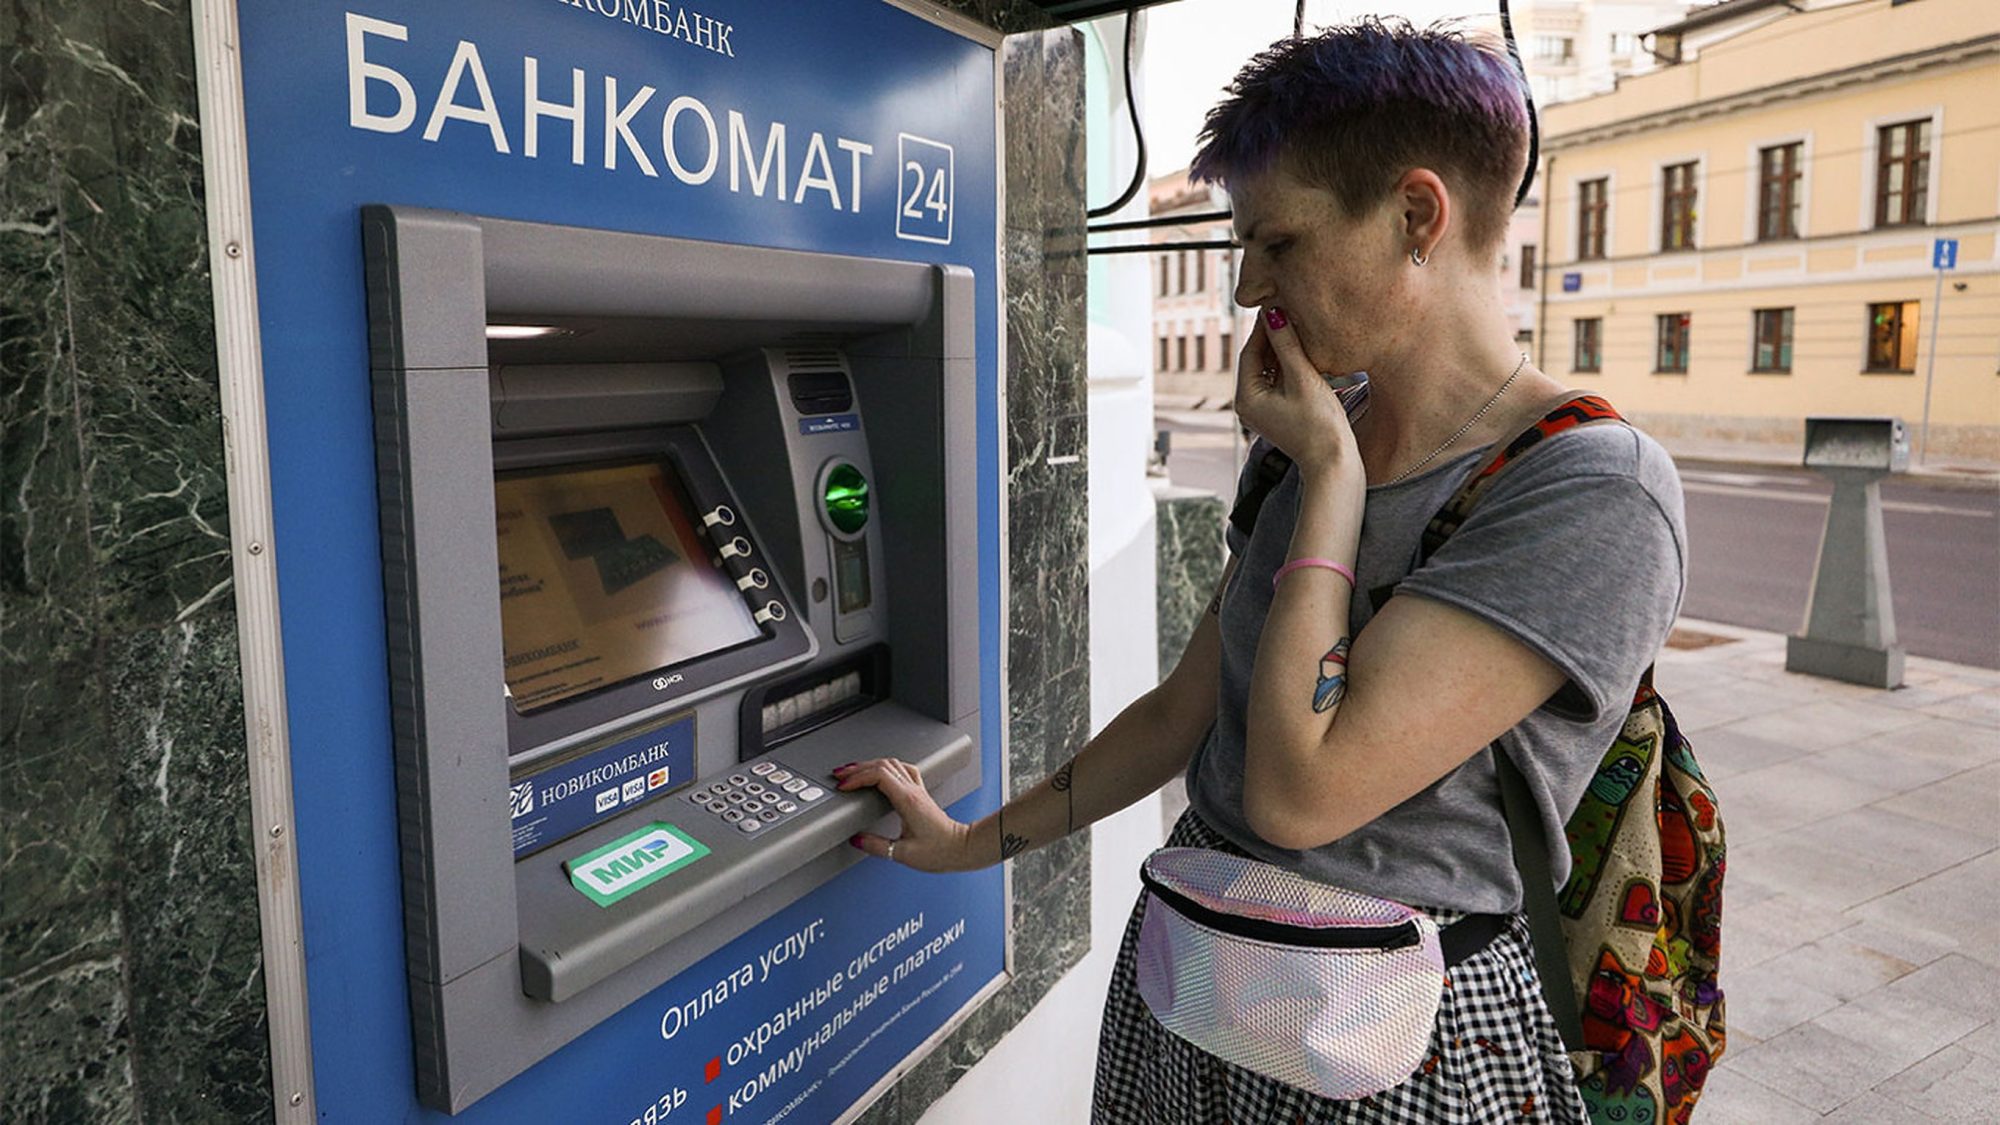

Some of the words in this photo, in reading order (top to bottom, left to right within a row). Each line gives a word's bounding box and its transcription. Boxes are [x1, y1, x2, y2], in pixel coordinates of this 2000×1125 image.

[557, 0, 735, 57] ОМБАНК
[345, 12, 873, 213] БАНКОМАТ
[903, 160, 947, 223] 24
[541, 742, 669, 807] НОВИКОМБАНК
[598, 792, 618, 807] VISA
[624, 782, 643, 796] VISA
[590, 839, 669, 885] МИР
[660, 962, 754, 1041] Оплата
[759, 918, 825, 982] услуг:
[726, 971, 843, 1066] охранные
[847, 911, 924, 980] системы
[728, 975, 890, 1116] коммунальные
[892, 918, 966, 985] платежи
